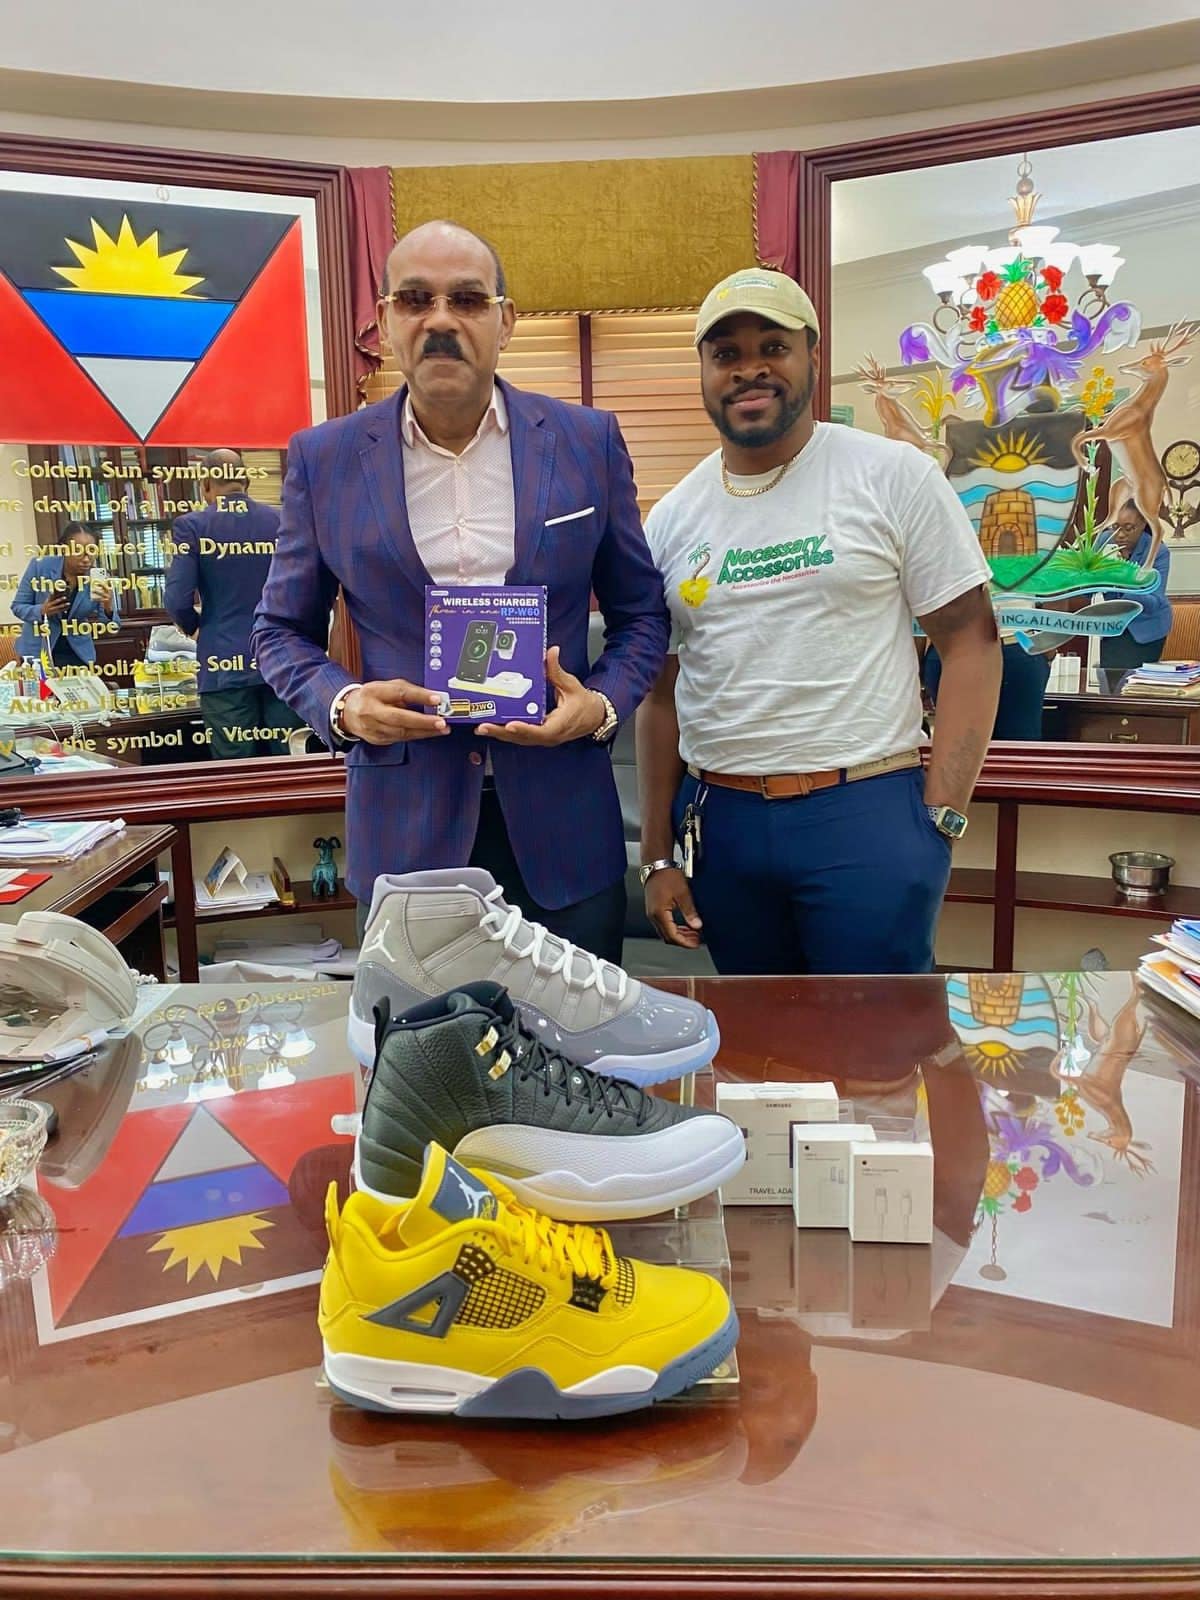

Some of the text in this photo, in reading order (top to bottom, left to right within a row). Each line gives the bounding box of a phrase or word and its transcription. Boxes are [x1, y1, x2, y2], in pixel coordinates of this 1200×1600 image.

[10, 459, 269, 483] Golden Sun symbolizes
[34, 495, 97, 513] dawn
[107, 496, 128, 513] of
[140, 500, 153, 513] a
[163, 500, 208, 513] new
[216, 496, 249, 513] Era
[159, 538, 190, 555] the
[725, 534, 827, 567] Necessary
[717, 549, 834, 585] Accessories
[31, 576, 67, 592] the
[443, 598, 539, 607] WIRELESS CHARGER
[501, 608, 540, 616] RP-W60
[33, 620, 51, 637] is
[60, 618, 119, 639] Hope
[1030, 616, 1051, 626] ALL
[1054, 619, 1123, 632] ACHIEVING
[207, 655, 244, 672] Soil
[63, 735, 97, 752] the
[107, 729, 184, 754] symbol
[192, 728, 213, 745] of
[222, 726, 293, 744] Victory
[749, 1187, 777, 1195] TRAVEL
